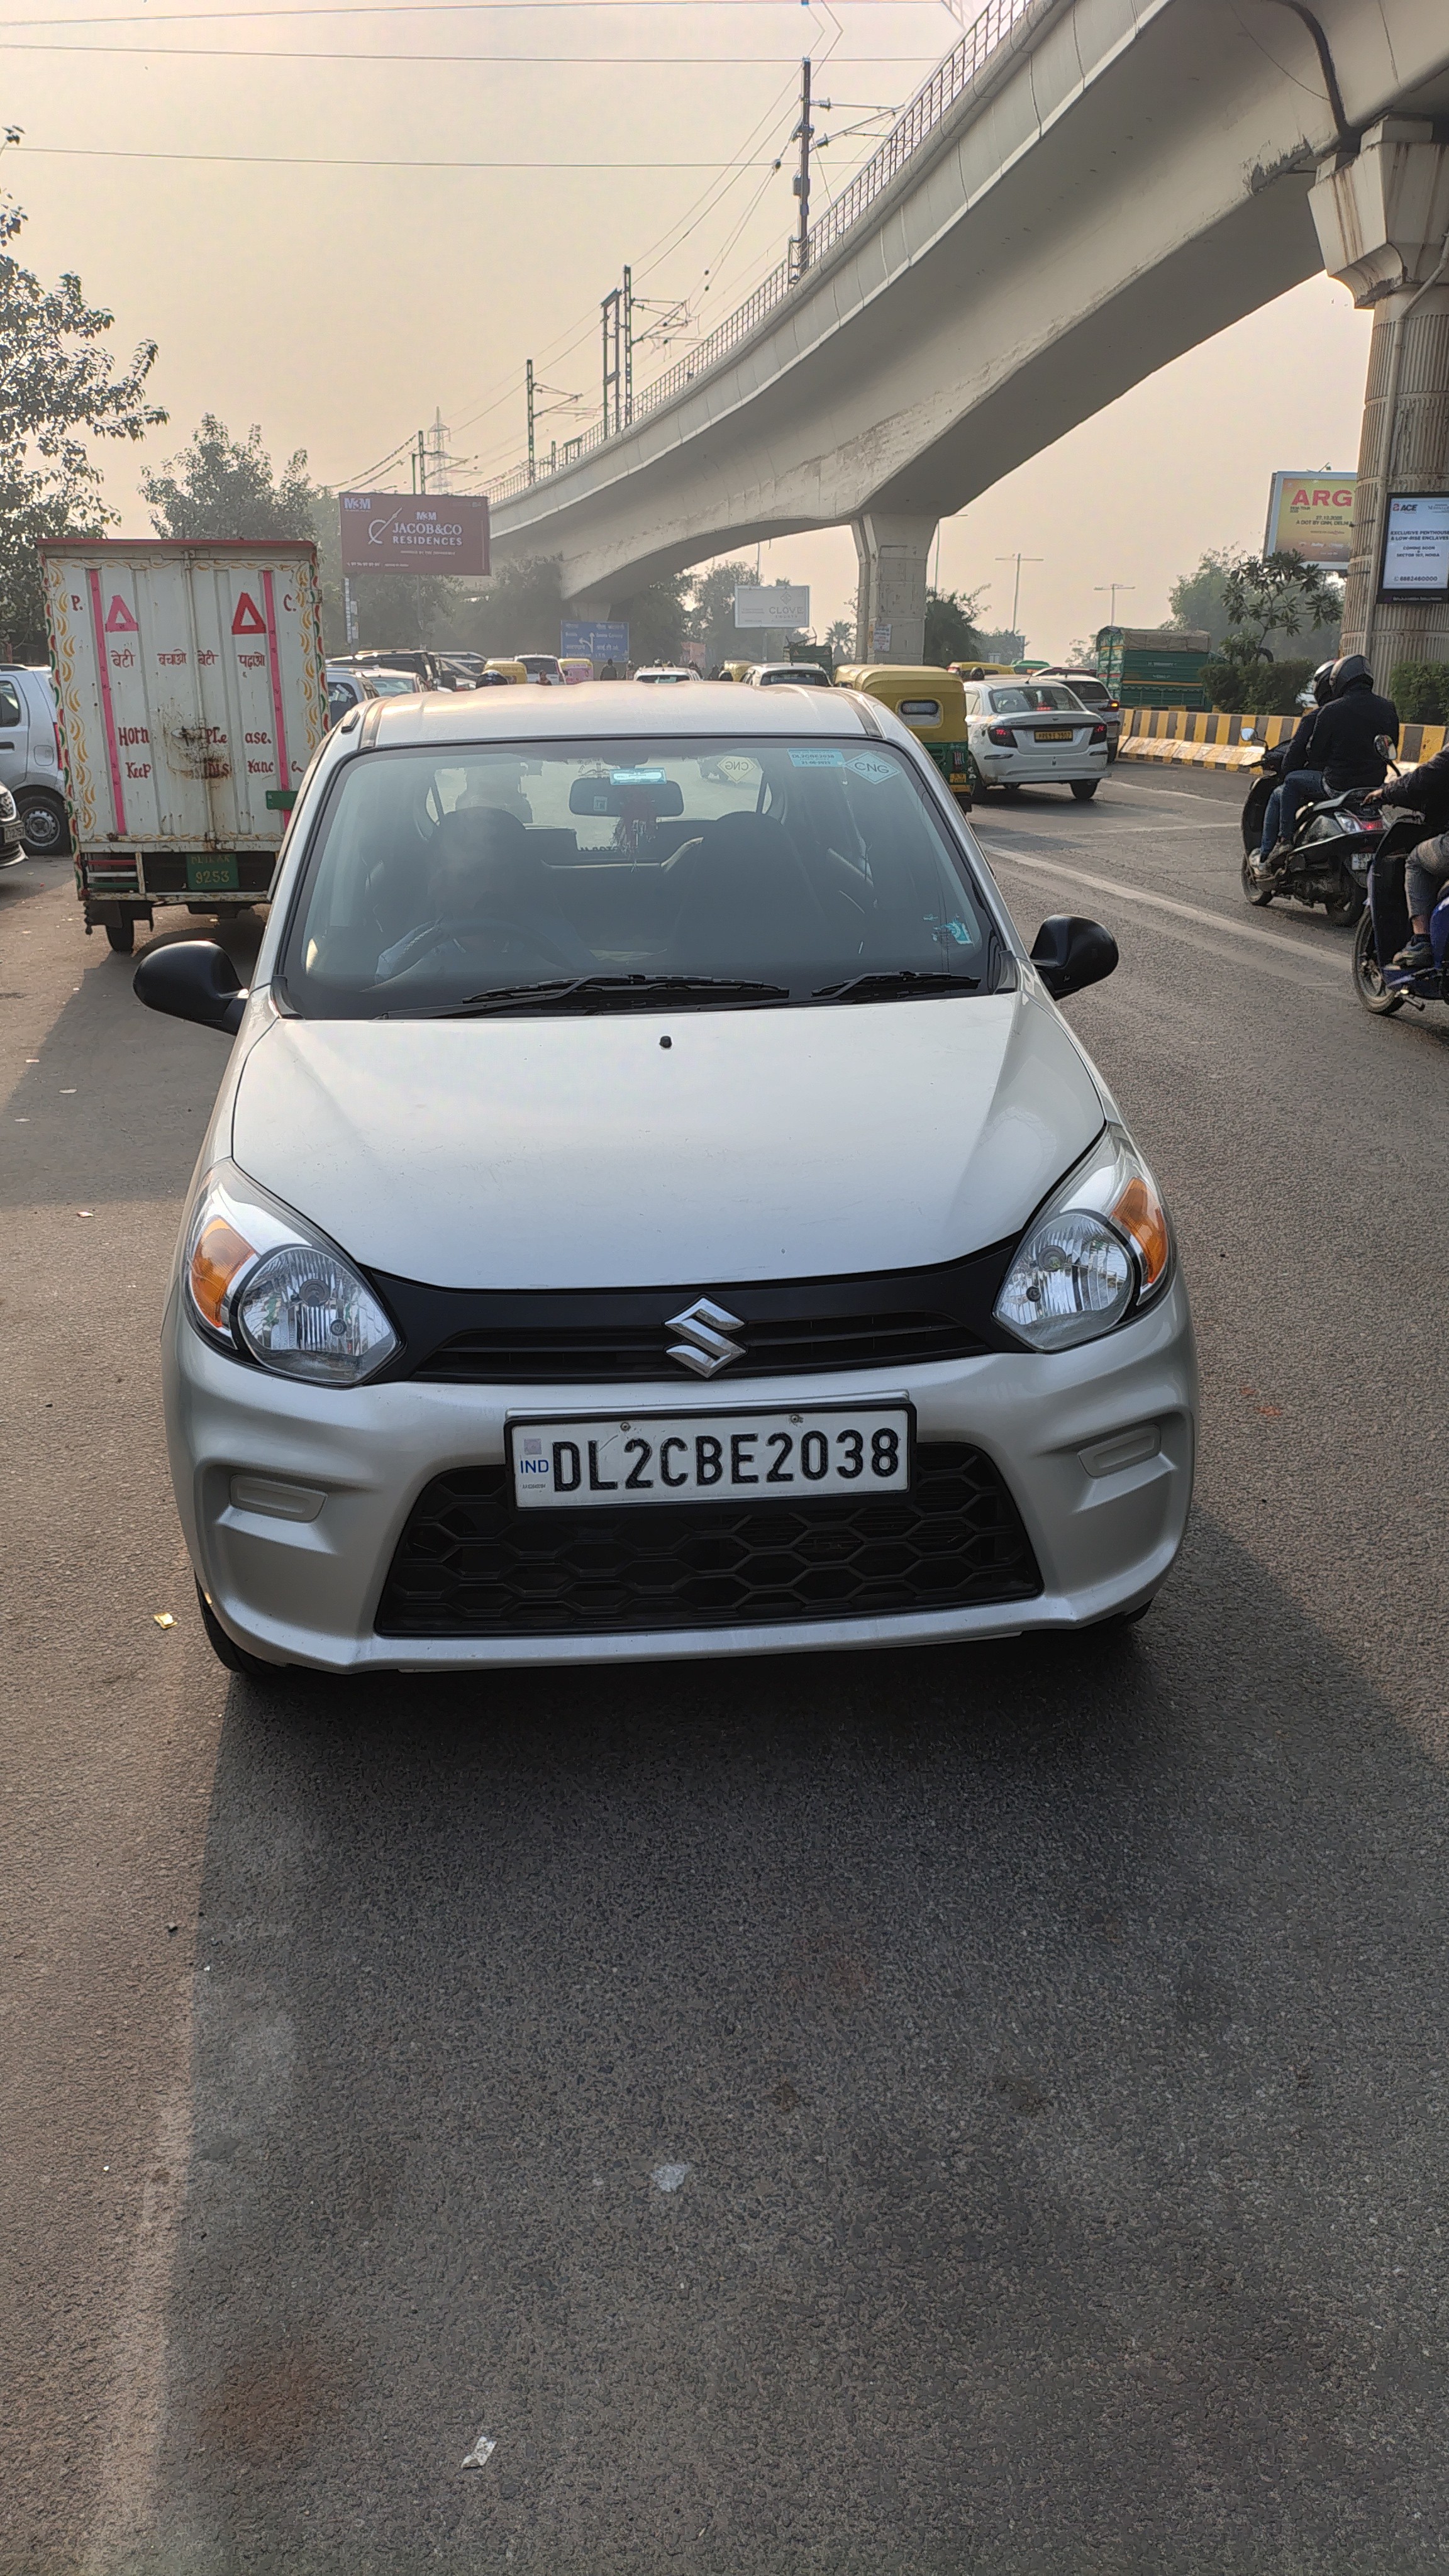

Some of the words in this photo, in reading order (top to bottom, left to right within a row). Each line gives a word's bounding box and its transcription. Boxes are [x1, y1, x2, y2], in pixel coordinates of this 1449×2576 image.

[392, 523, 462, 535] JACOB&CO
[392, 536, 462, 546] RESIDENCES
[111, 648, 136, 668] बेटी
[197, 650, 219, 667] बेटी
[855, 762, 889, 774] CNG
[552, 1427, 899, 1492] DL2CBE2038
[520, 1459, 549, 1474] IND
